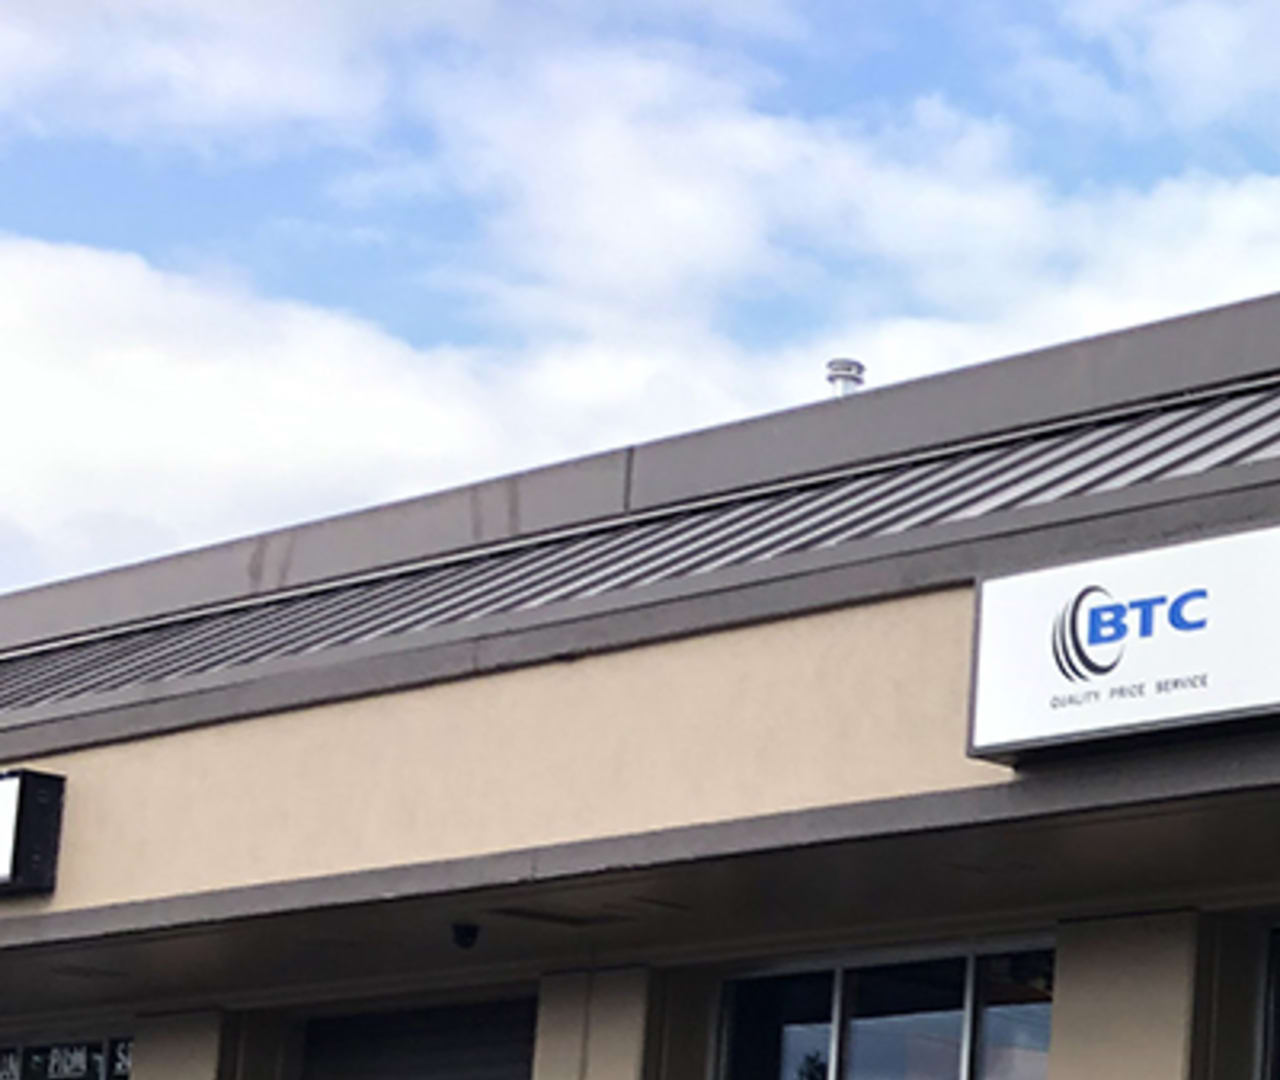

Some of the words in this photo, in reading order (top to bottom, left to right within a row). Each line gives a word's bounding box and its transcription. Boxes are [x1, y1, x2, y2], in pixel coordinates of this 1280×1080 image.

[1088, 589, 1208, 646] BTC
[1050, 690, 1100, 709] QUALITY
[1110, 682, 1146, 699] PRICE
[1155, 674, 1208, 694] SERVICE
